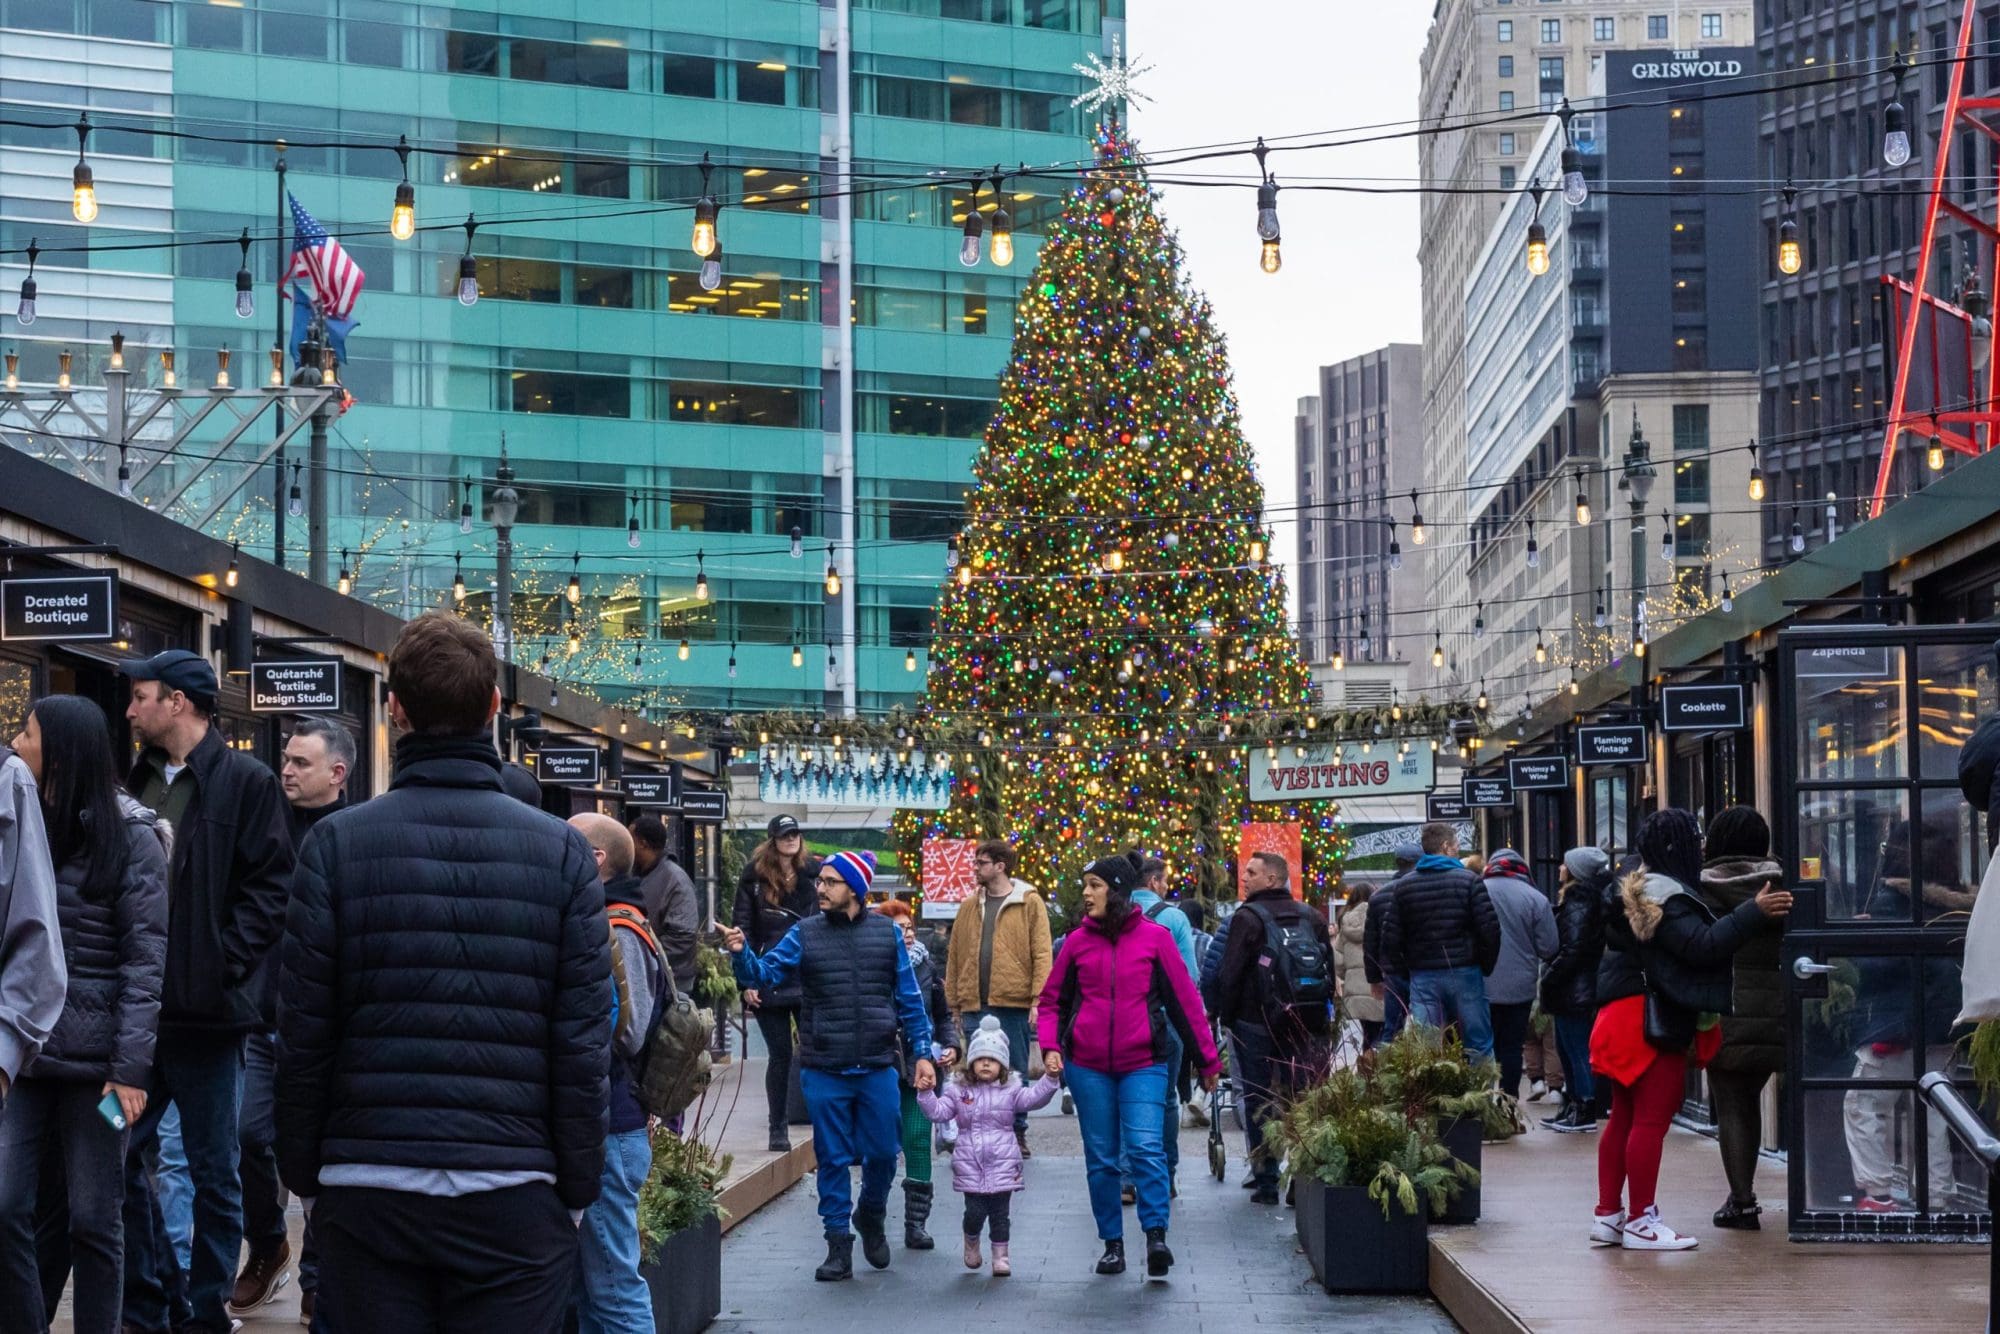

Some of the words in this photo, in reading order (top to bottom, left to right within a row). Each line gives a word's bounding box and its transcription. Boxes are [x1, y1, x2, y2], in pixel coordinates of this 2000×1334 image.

[1673, 50, 1700, 60] THE
[1631, 60, 1742, 79] GRISWOLD
[24, 593, 88, 608] Dcreated
[24, 610, 89, 625] Boutique
[266, 668, 324, 679] Quétarshé
[274, 681, 317, 691] Textiles
[257, 693, 295, 706] Design
[297, 692, 334, 703] Studio
[1680, 702, 1726, 713] Cookette
[1593, 736, 1633, 745] Flamingo
[1596, 745, 1629, 754] Vintage
[545, 757, 565, 766] Opal
[565, 757, 590, 765] Grove
[1403, 759, 1417, 767] EXIT
[554, 765, 582, 774] Games
[1401, 767, 1418, 776] HERE
[1520, 766, 1549, 774] Whimsy
[1267, 760, 1390, 791] VISITING
[642, 783, 661, 791] Sorry
[1479, 782, 1499, 790] Young
